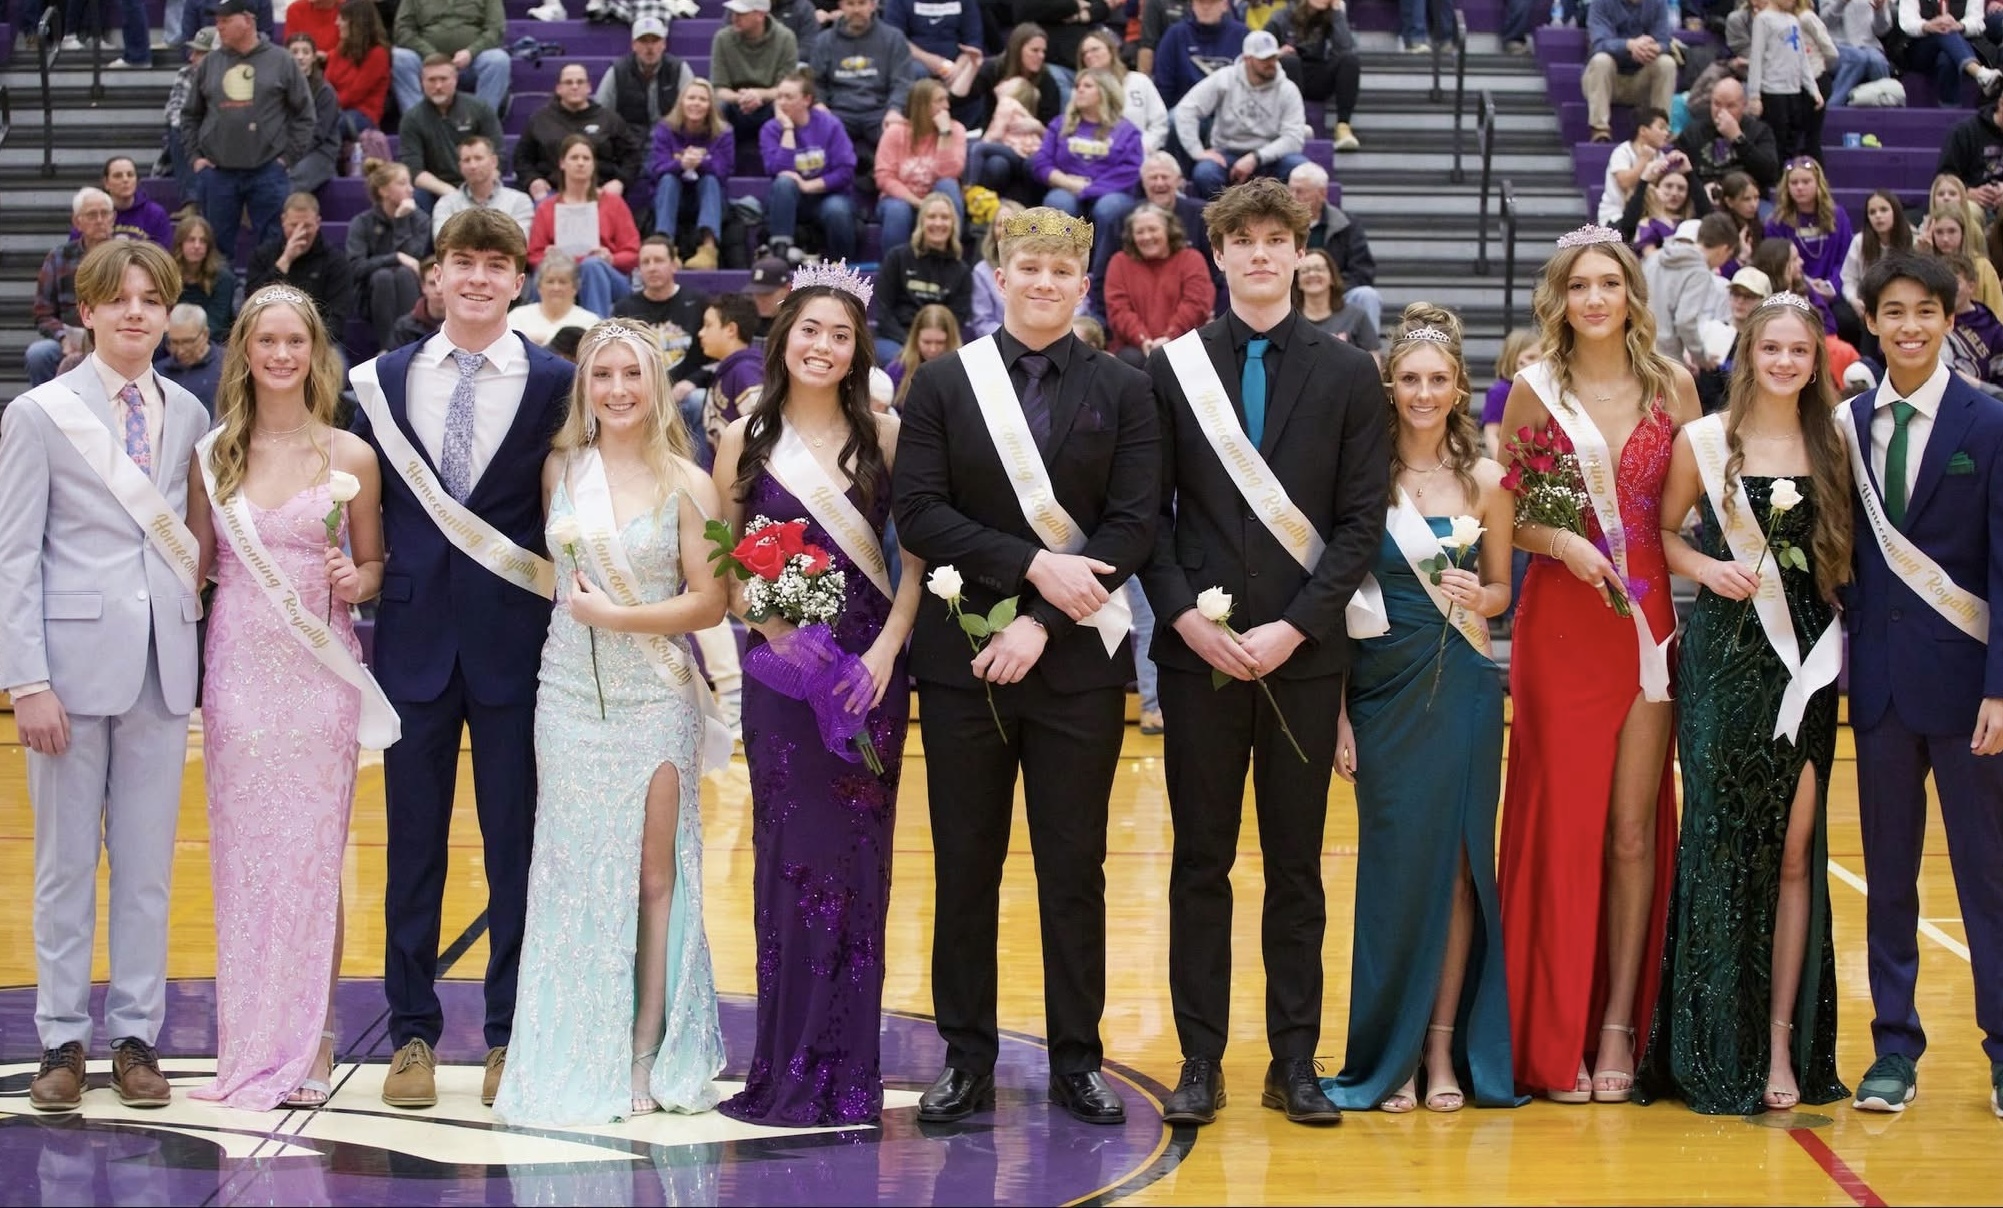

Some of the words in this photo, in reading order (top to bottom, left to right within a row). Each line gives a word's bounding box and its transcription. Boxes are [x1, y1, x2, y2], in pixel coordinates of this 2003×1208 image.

[1130, 91, 1144, 107] S
[1199, 391, 1262, 489] Homecoming
[406, 460, 483, 549] Homecoming
[810, 486, 885, 575] Homecoming
[1861, 483, 1923, 576] Homecoming
